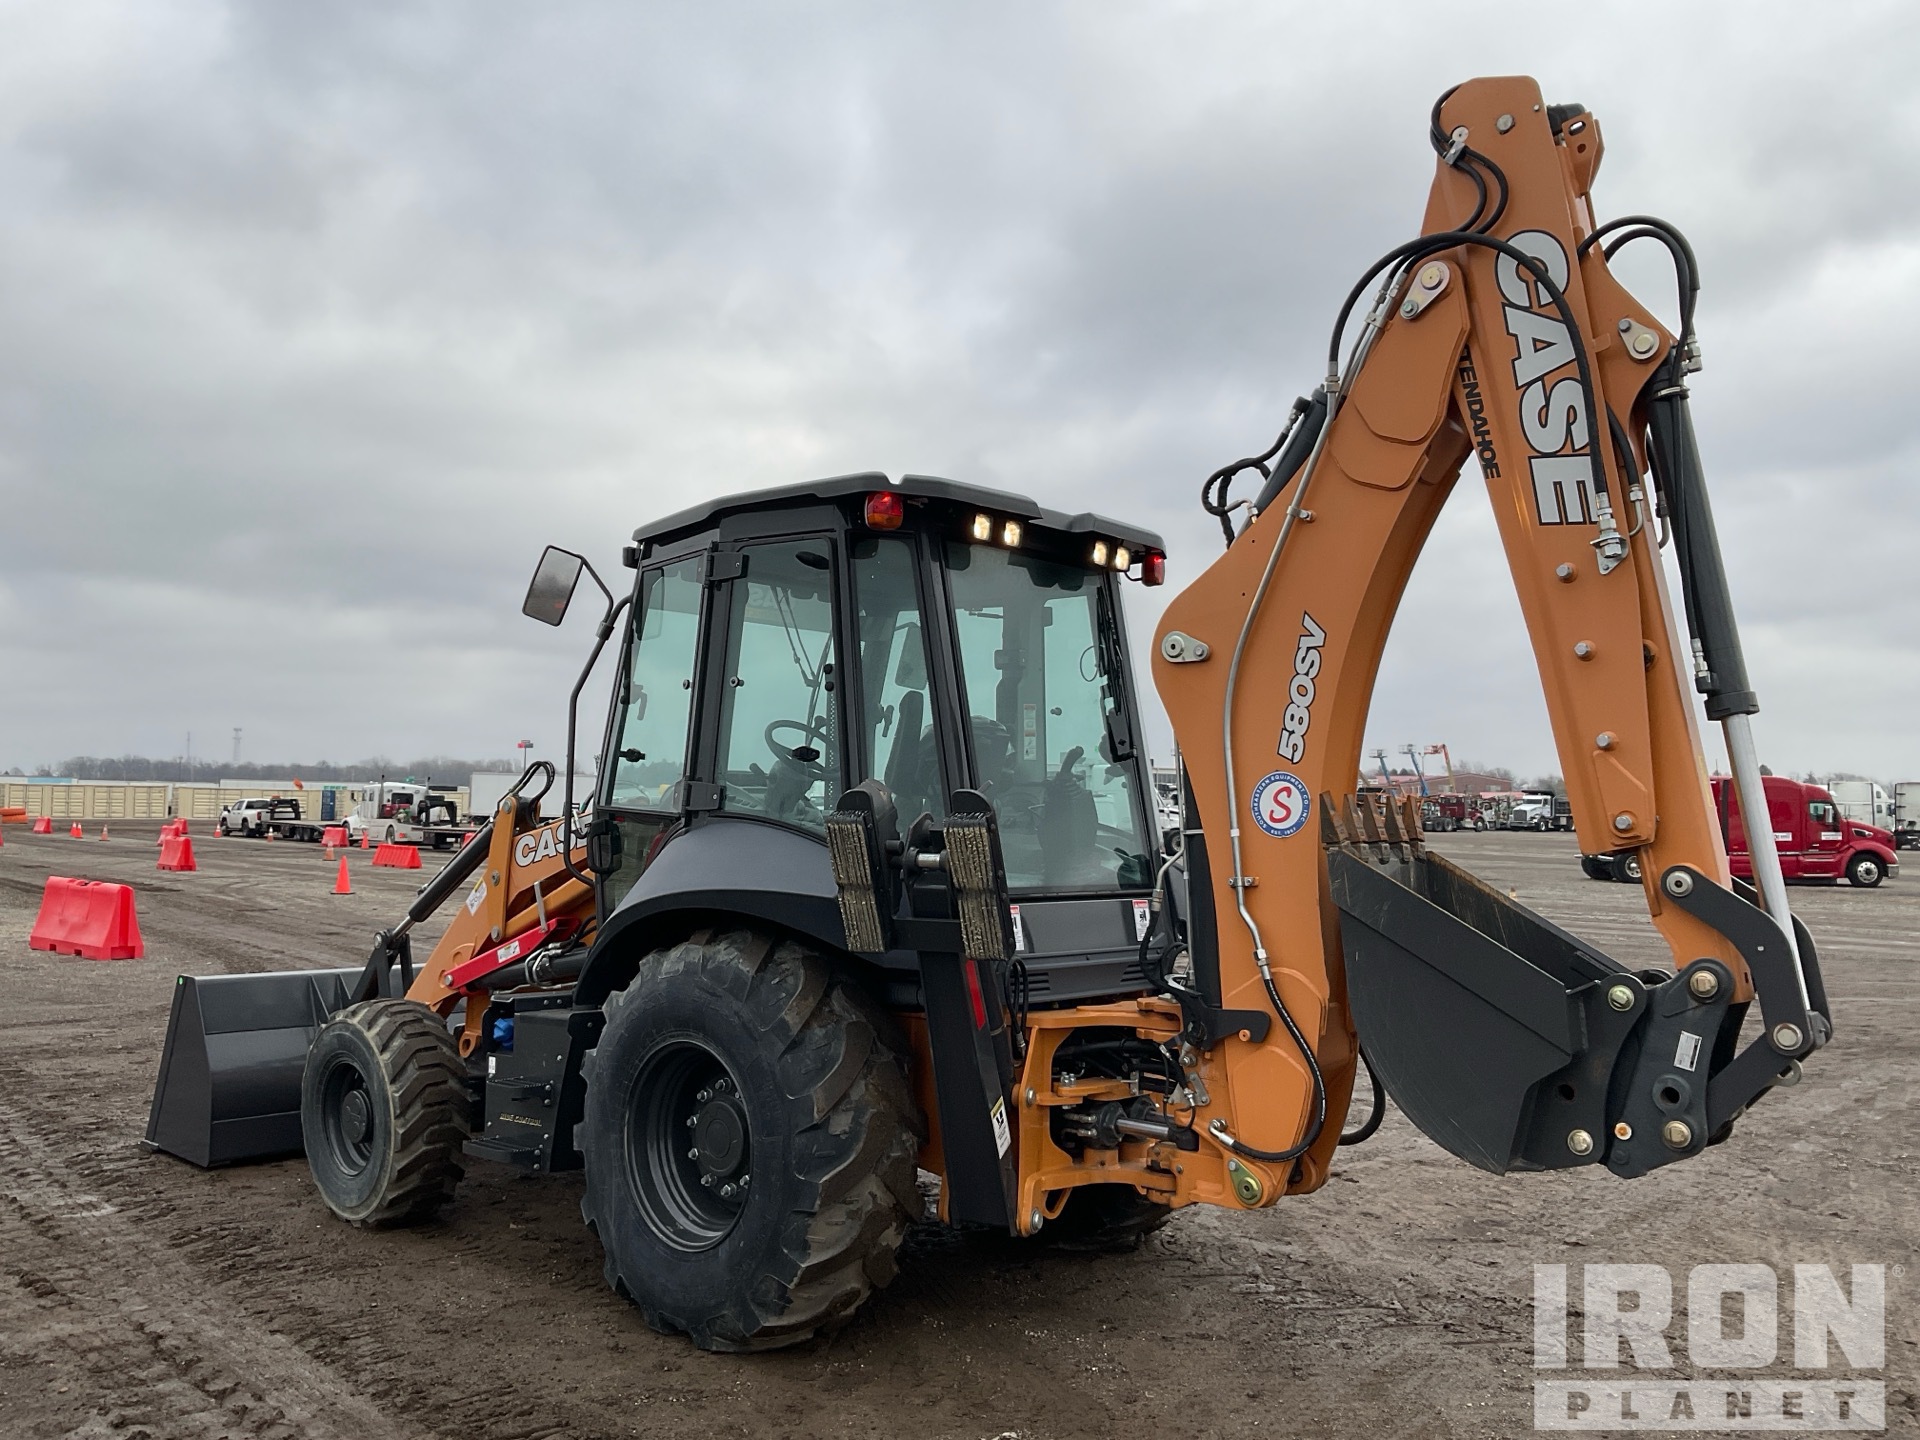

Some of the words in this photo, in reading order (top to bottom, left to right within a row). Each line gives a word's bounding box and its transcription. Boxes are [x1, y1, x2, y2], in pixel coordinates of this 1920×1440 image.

[1459, 345, 1501, 480] TENDAHOE
[1495, 229, 1600, 526] CASE
[1277, 610, 1327, 764] 580SV
[514, 812, 593, 868] CASE
[1253, 778, 1271, 829] SOUTHEASTERN
[1270, 774, 1306, 792] EQUIPMENT
